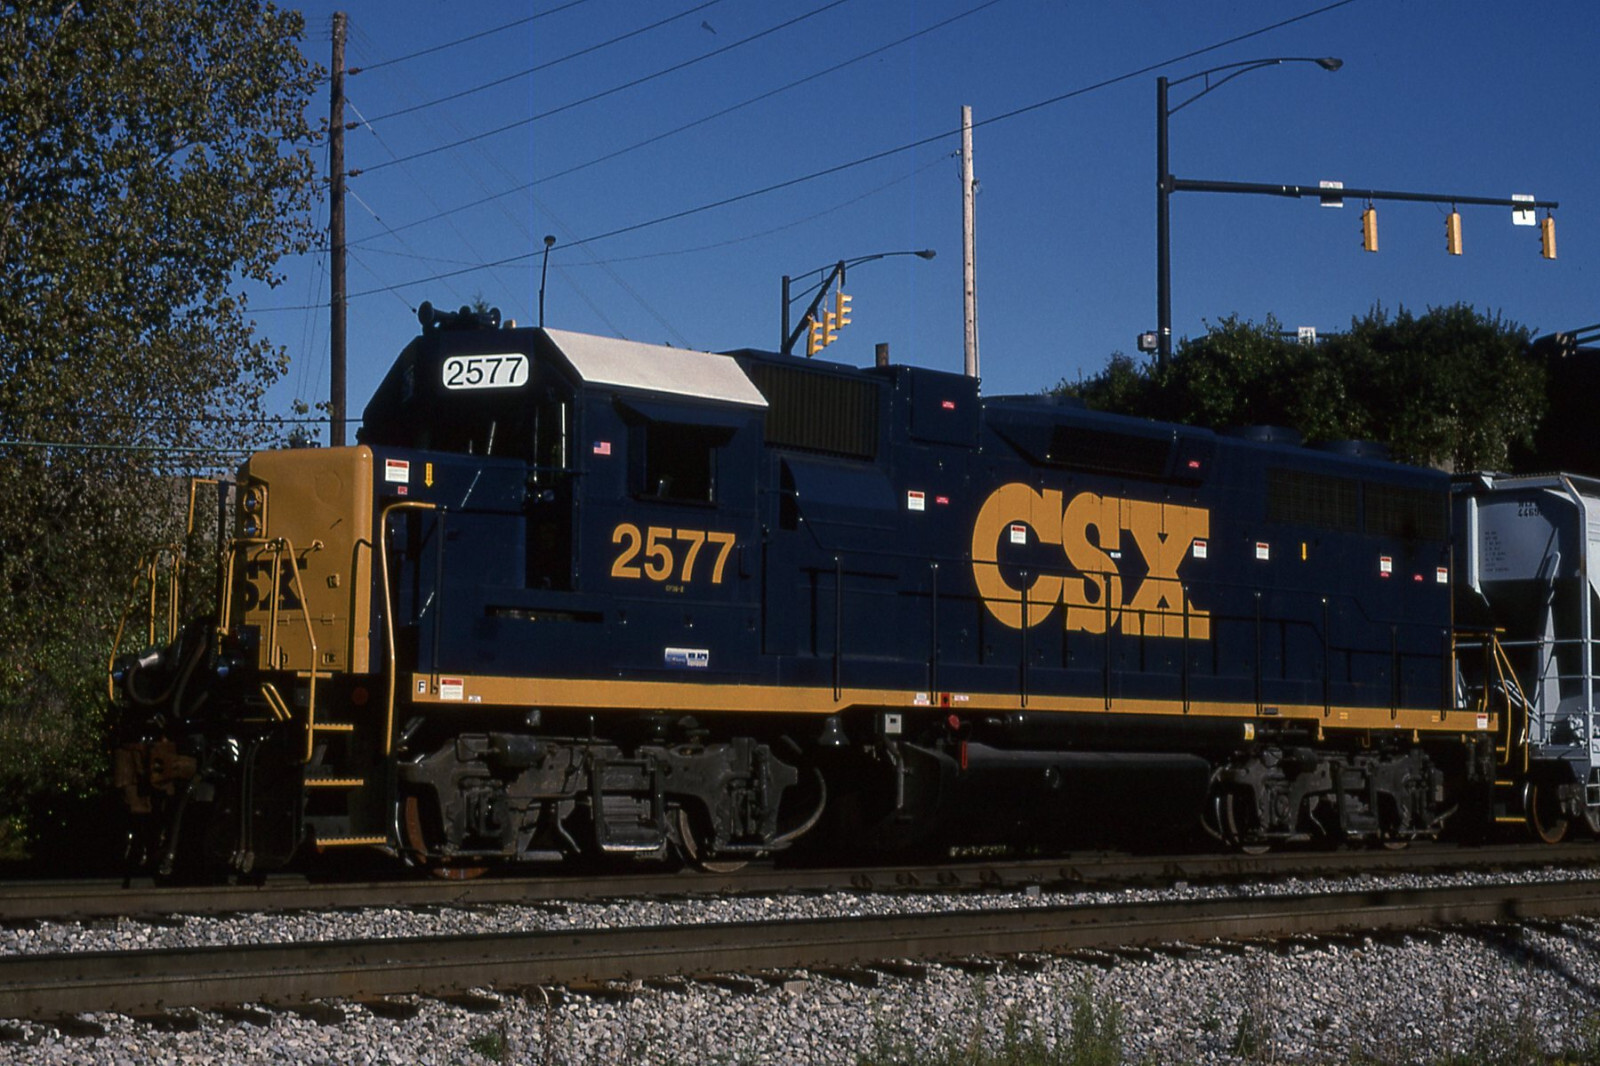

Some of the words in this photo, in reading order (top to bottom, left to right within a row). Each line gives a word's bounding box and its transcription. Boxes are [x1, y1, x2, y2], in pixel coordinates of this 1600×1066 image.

[447, 356, 523, 386] 2577
[610, 523, 736, 584] 2577
[971, 482, 1210, 640] CSX
[417, 681, 425, 692] F
